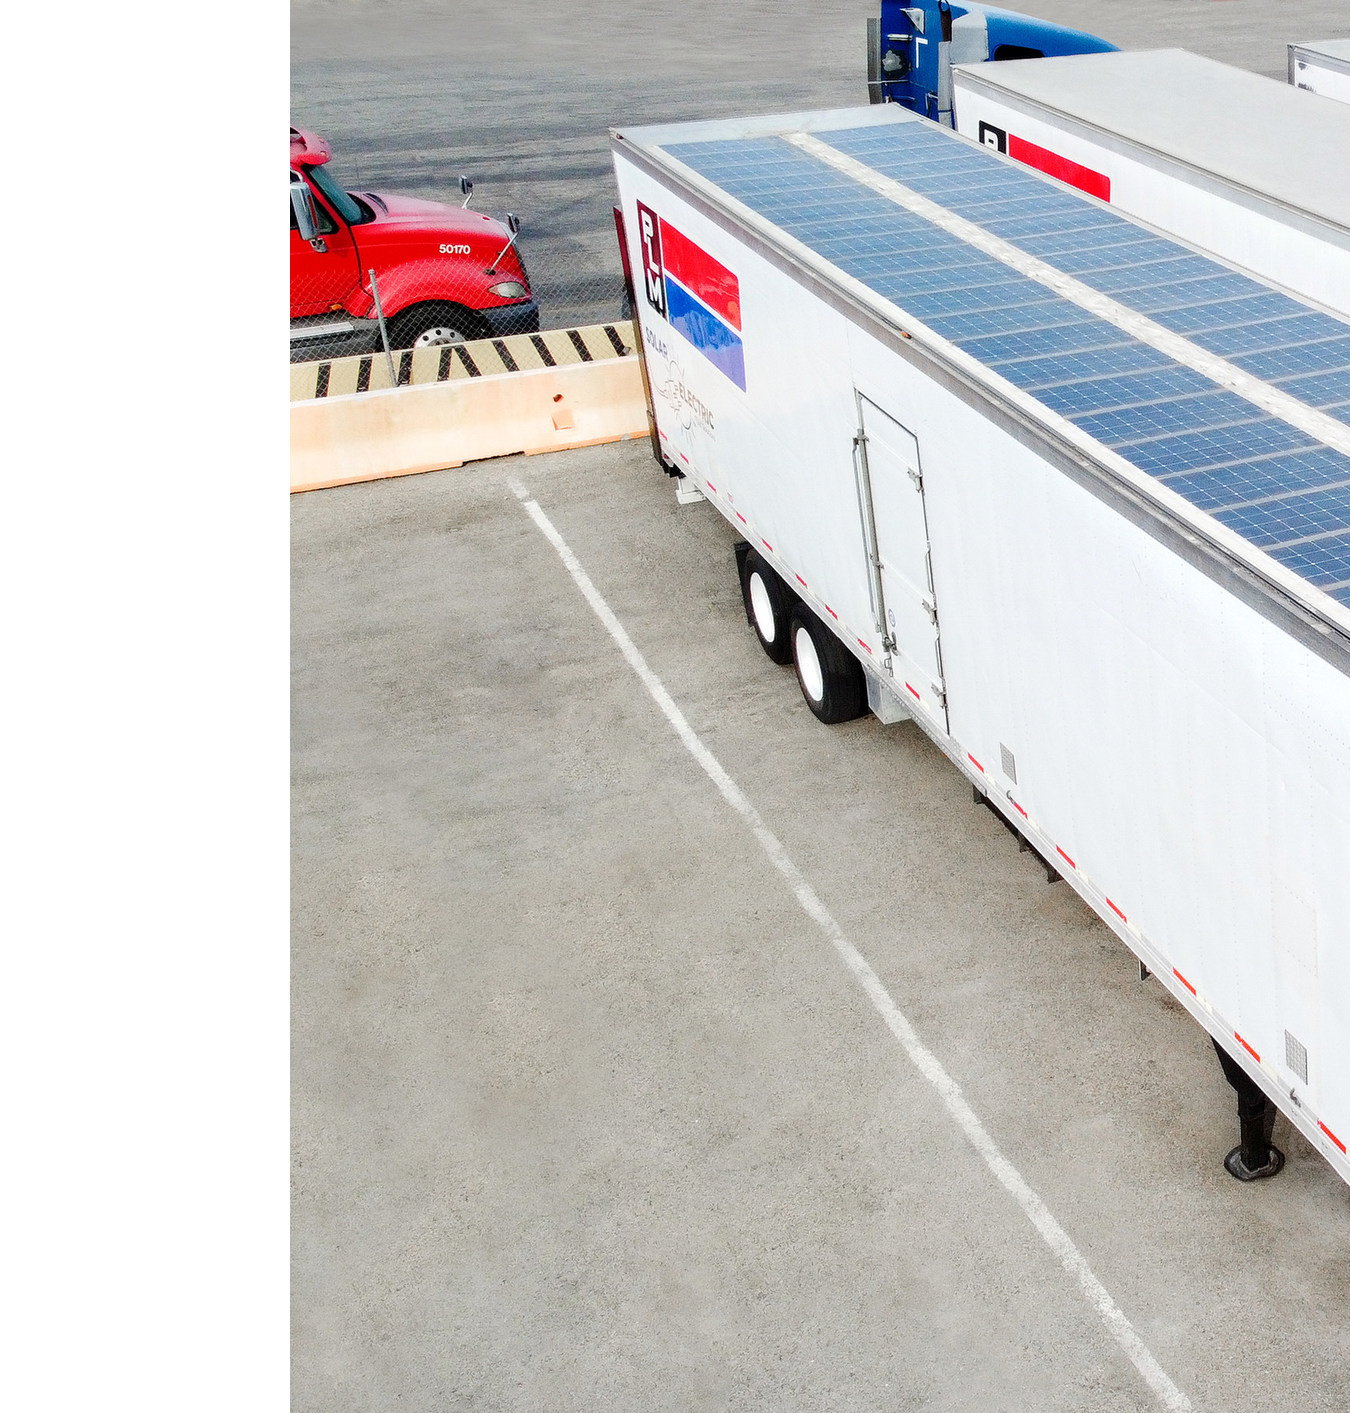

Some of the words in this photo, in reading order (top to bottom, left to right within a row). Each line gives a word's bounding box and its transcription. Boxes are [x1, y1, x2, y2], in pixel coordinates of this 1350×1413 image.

[439, 244, 471, 255] 50170
[641, 209, 664, 311] PLM
[646, 326, 669, 361] SOLAR
[678, 381, 714, 430] ELECTRIC
